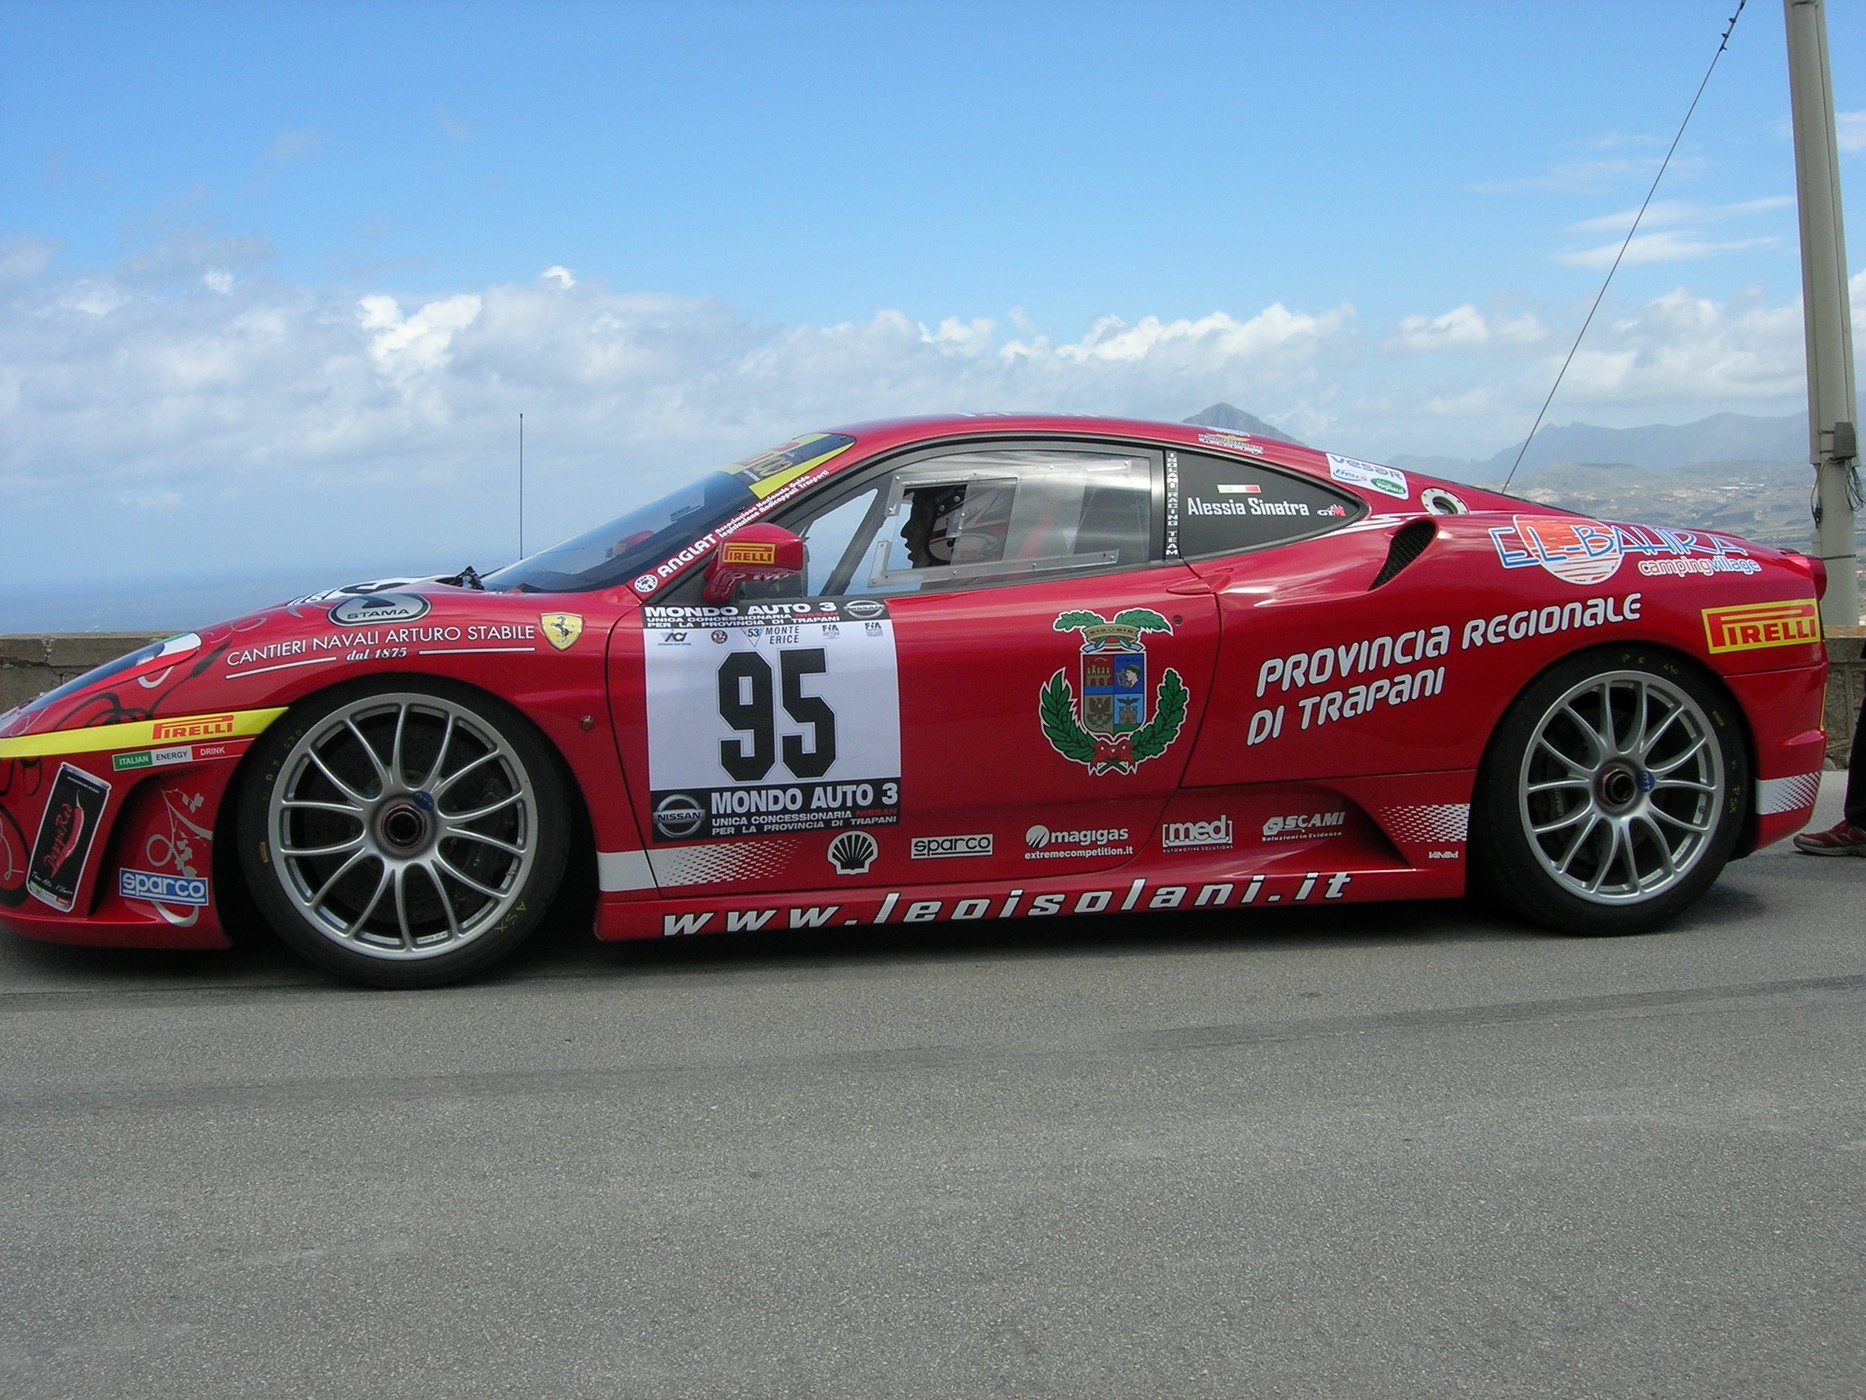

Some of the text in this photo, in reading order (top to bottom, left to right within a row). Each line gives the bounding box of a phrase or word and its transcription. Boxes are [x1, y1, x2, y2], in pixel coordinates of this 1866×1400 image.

[756, 487, 790, 509] Nazionale
[789, 474, 811, 490] Guida
[1166, 453, 1178, 555] ISOLANI RACING TEAM
[1187, 497, 1310, 516] Alessia Sinatra
[724, 546, 773, 562] PIRELLI
[346, 607, 411, 619] STAMA
[644, 602, 837, 618] MONDO AUTO 3
[689, 613, 792, 622] CONCESSIONARIA
[701, 619, 765, 627] PROVINCIA
[791, 616, 840, 624] TRAPANI
[765, 625, 800, 636] MONTE
[1706, 603, 1818, 648] PIRELLI
[227, 626, 535, 666] CANTIERI NAVALI ARTURO STABILE
[769, 635, 800, 645] ERICE
[1256, 592, 1642, 698] PROVINCIA REGIONALE
[346, 647, 408, 661] dal 1875
[717, 647, 836, 782] 95
[1246, 666, 1445, 746] DI TRAPANI
[152, 714, 235, 740] PIRELLI
[119, 747, 226, 766] ITALIAN ENERGY DRINK
[711, 782, 899, 814] MONDO AUTO 3
[657, 811, 701, 822] NISSAN
[712, 808, 898, 827] UNICA CONCESSIONARIA NISSAN
[712, 826, 735, 836] PER
[742, 825, 757, 834] LA
[764, 821, 825, 832] PROVINCIA
[851, 816, 897, 826] TRAPANI
[1051, 828, 1129, 846] magigas
[1168, 815, 1228, 842] med
[1262, 833, 1299, 842] Soluzioni
[1309, 831, 1342, 839] Evidenza
[913, 836, 992, 856] sparco
[1025, 846, 1134, 860] extremecompetition.it
[122, 872, 205, 902] sparco
[664, 872, 1352, 936] www.leoisolani.it
